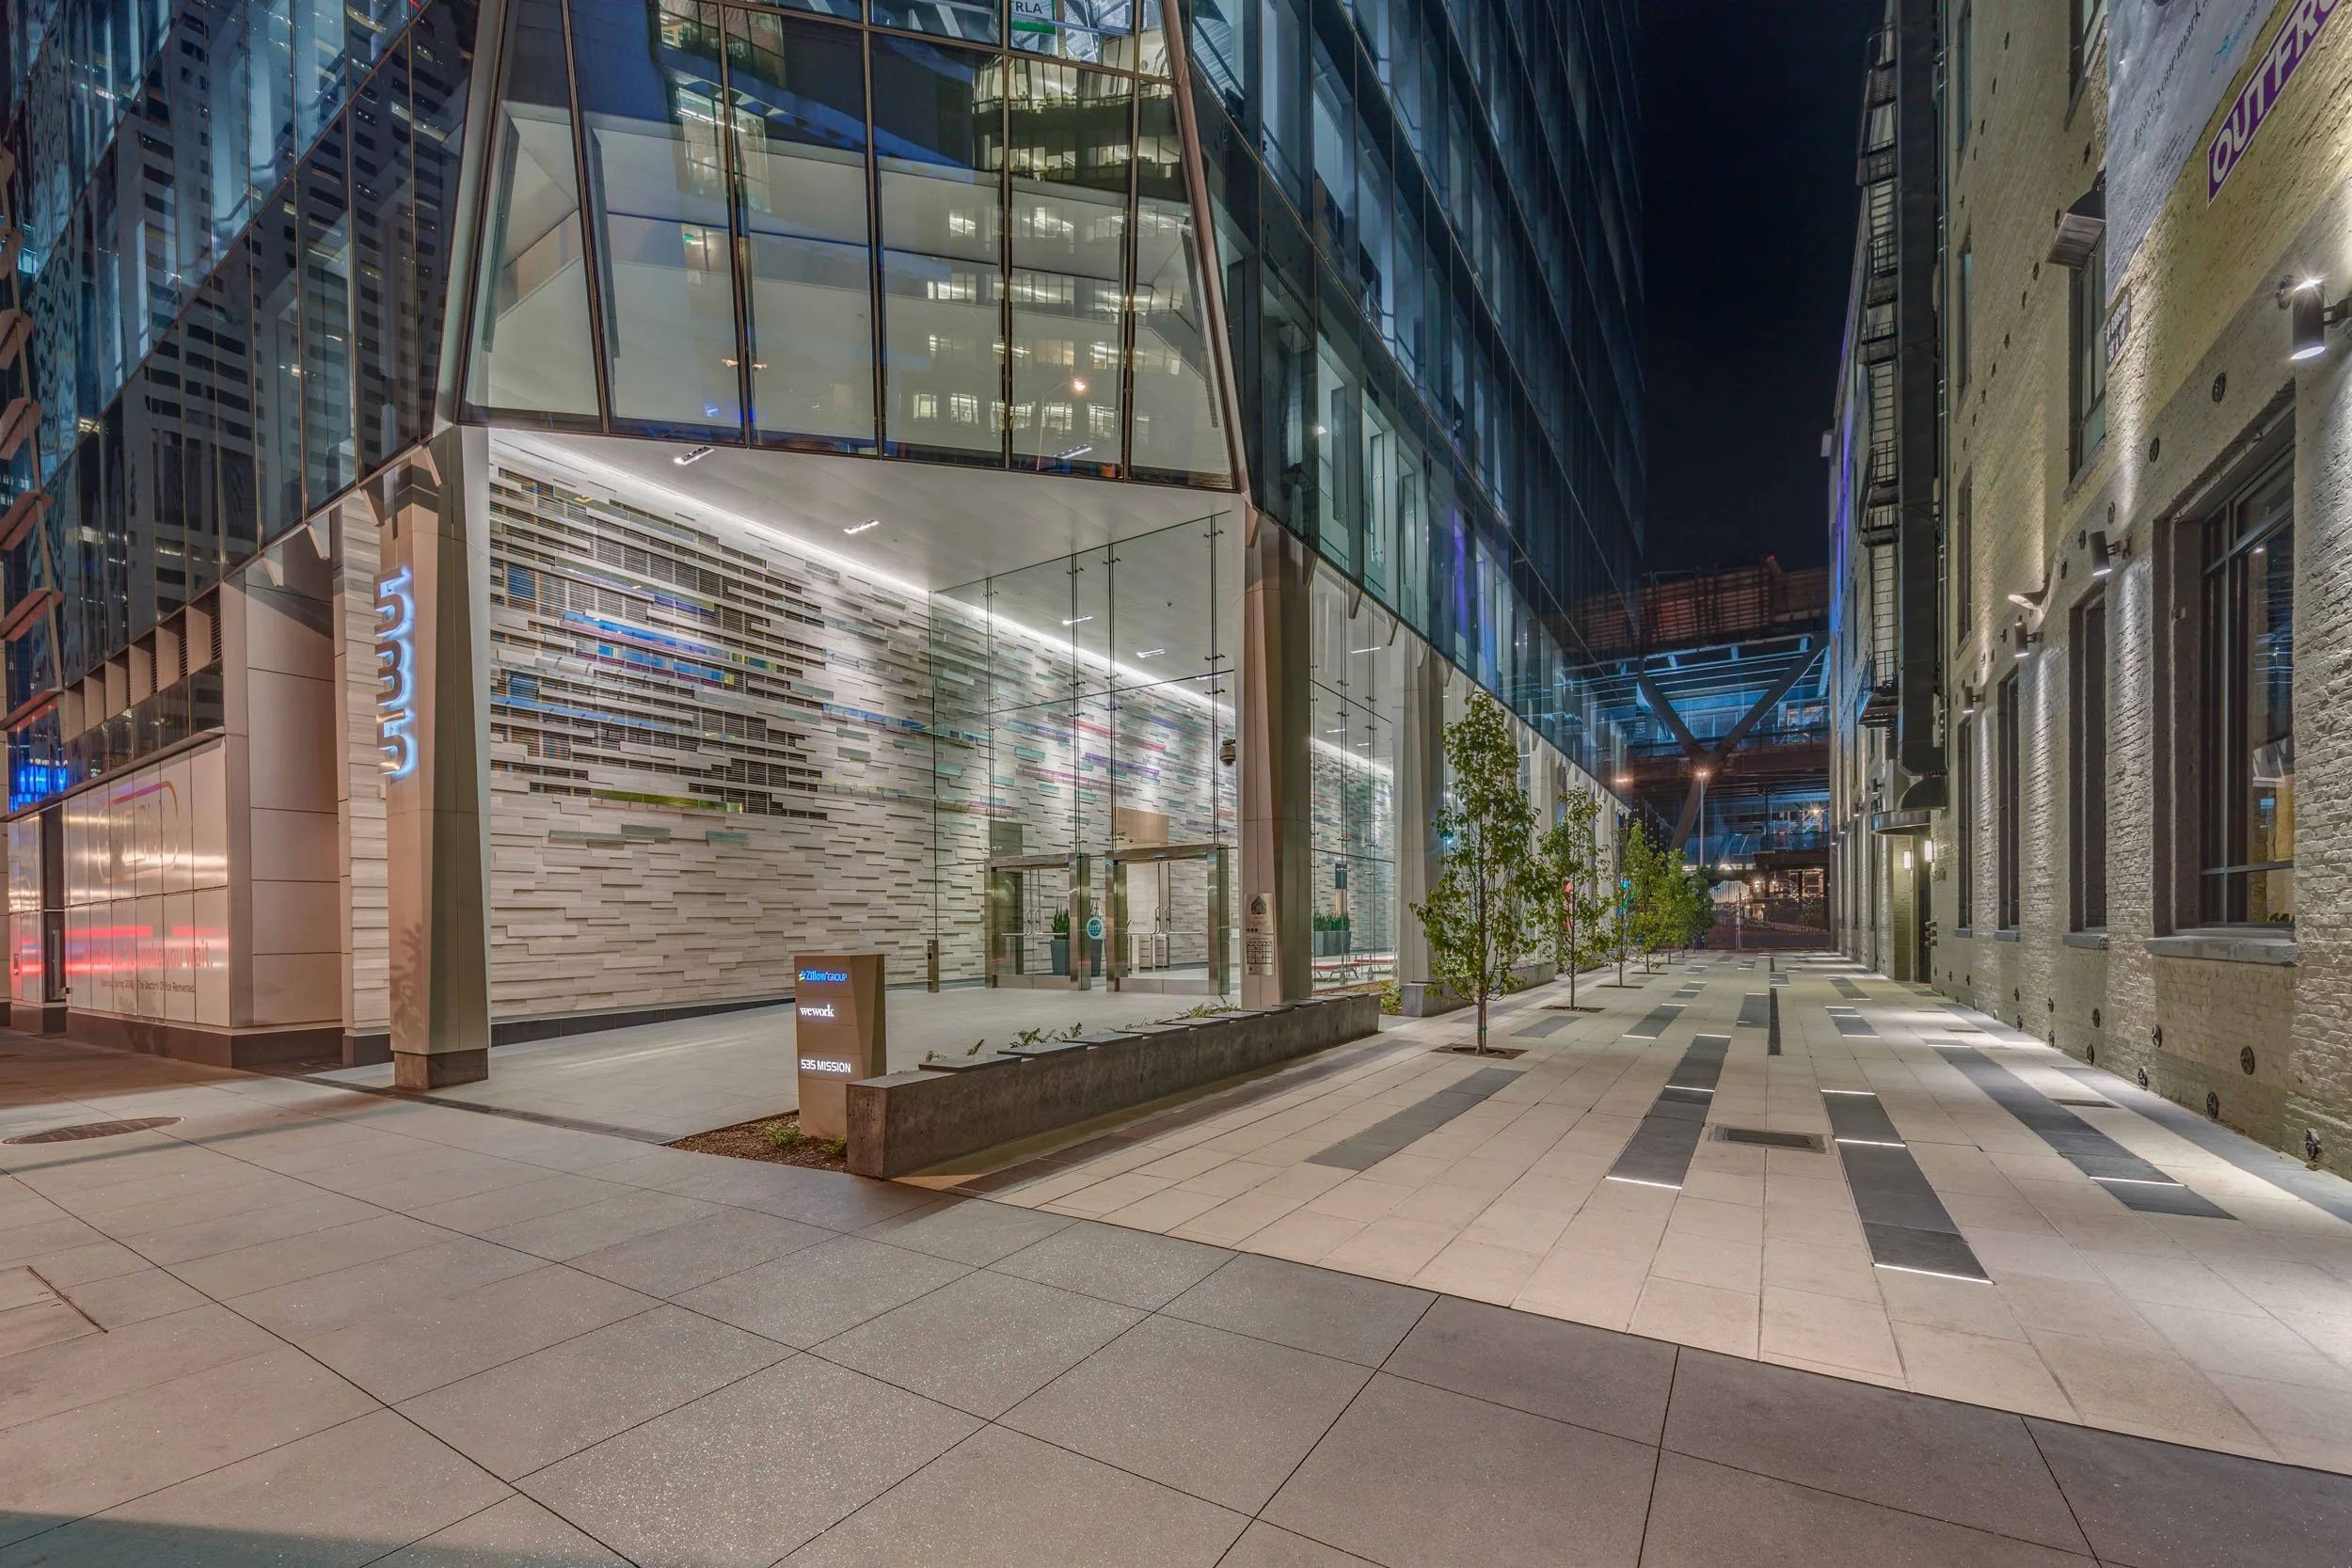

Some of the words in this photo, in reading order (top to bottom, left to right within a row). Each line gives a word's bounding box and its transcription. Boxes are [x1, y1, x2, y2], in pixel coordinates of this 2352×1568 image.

[1010, 0, 1043, 14] RLA
[2177, 0, 2201, 59] mark
[373, 565, 406, 775] 535
[165, 947, 183, 974] you
[184, 939, 213, 968] wait.
[805, 971, 827, 981] Zillow
[827, 973, 847, 982] GROUP
[800, 1005, 834, 1017] wework
[801, 1059, 817, 1069] 535
[817, 1060, 851, 1073] MISSION
